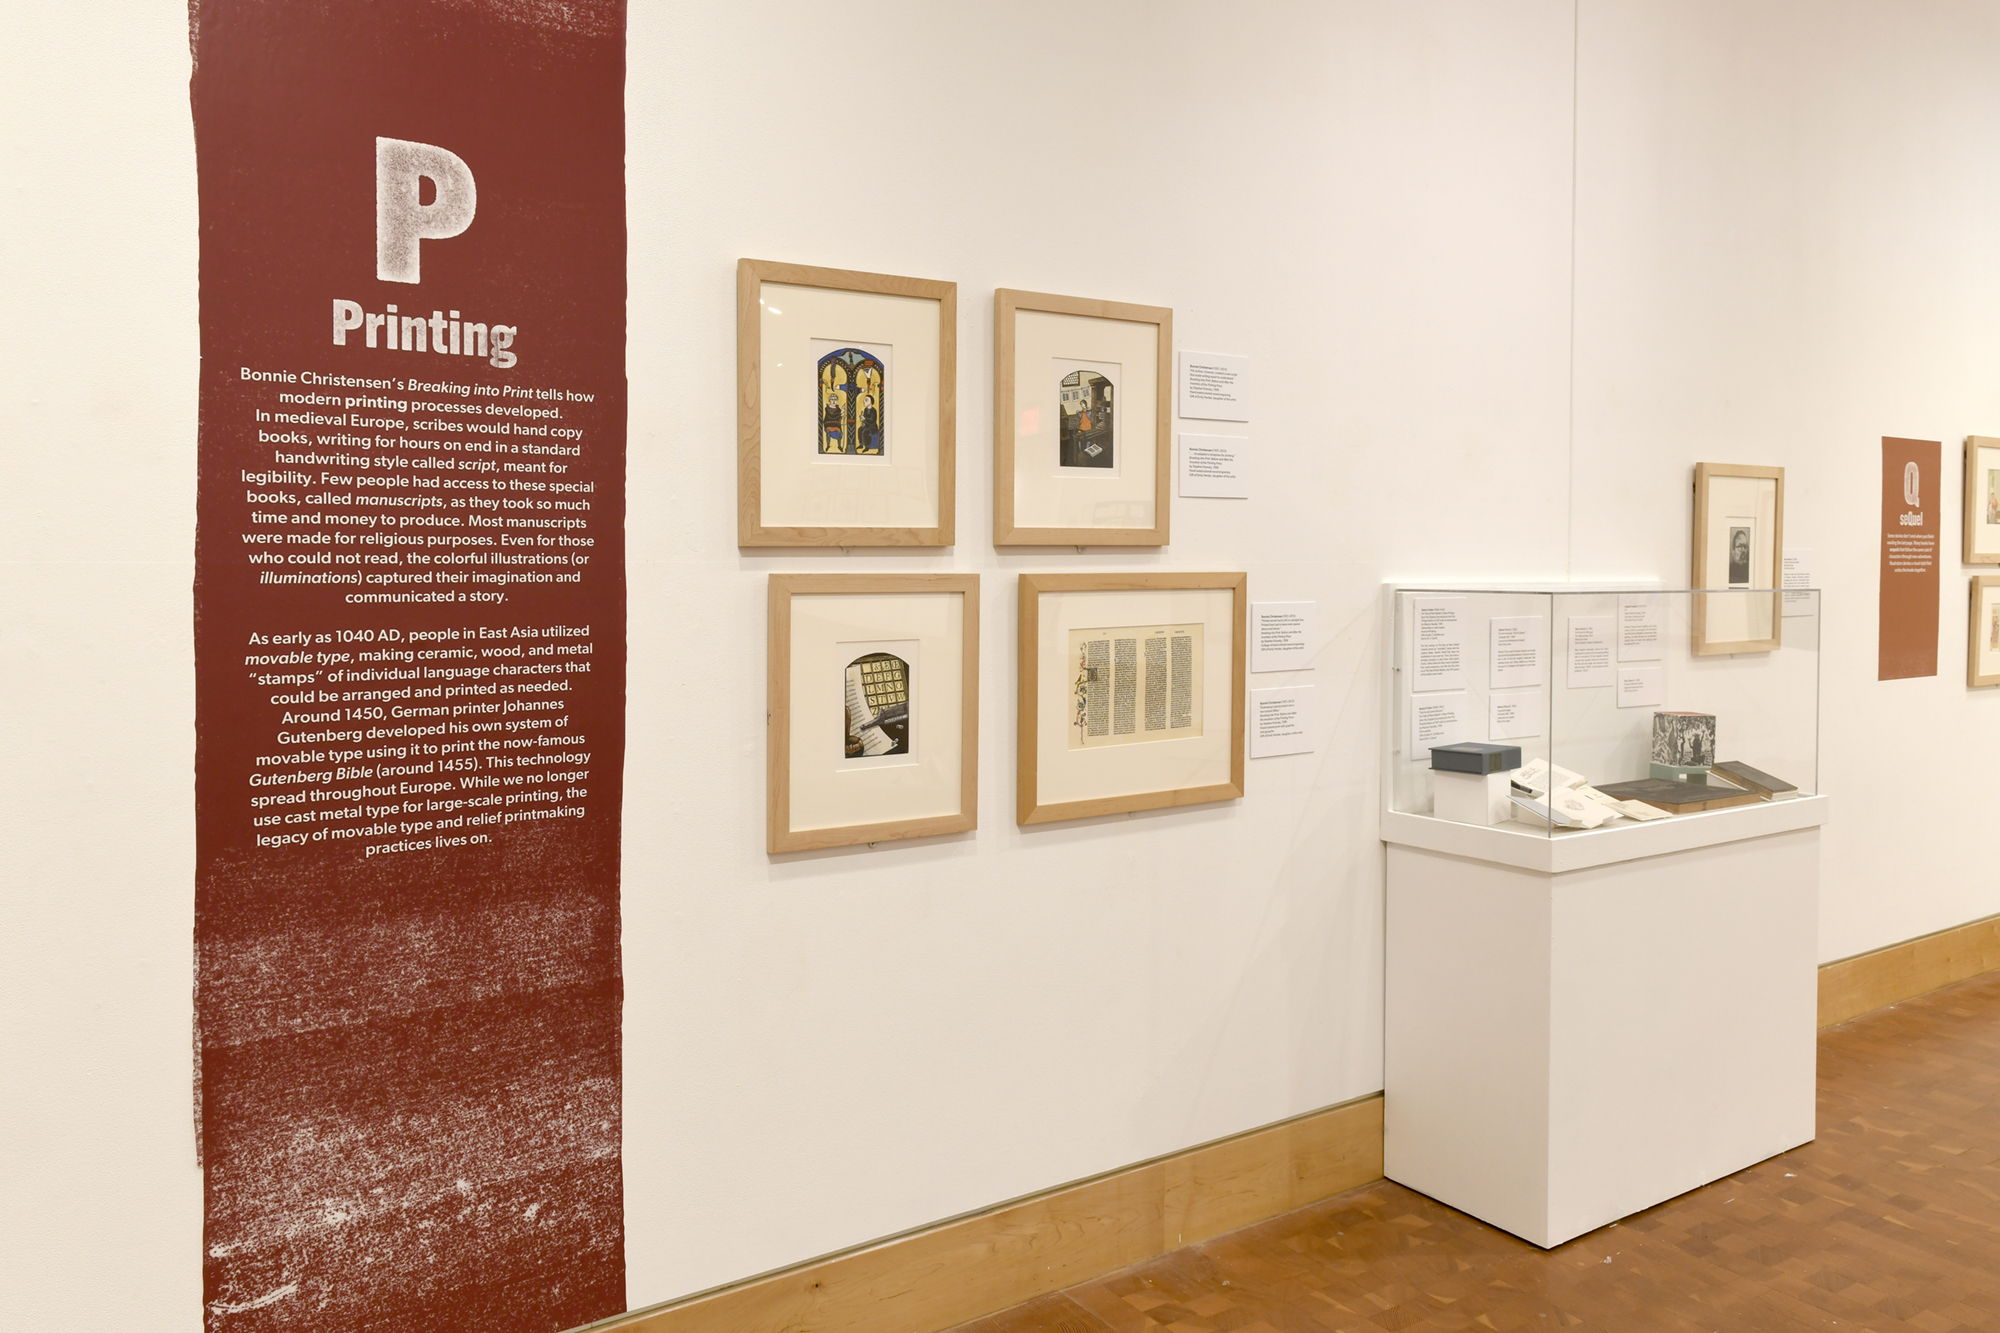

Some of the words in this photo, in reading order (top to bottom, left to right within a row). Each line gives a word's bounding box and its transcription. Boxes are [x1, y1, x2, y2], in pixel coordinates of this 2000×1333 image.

[376, 136, 477, 284] P
[333, 299, 517, 368] Printing
[240, 367, 297, 383] Bonnie
[300, 371, 405, 391] Christensen's
[407, 378, 471, 398] Breaking
[473, 383, 500, 397] into
[502, 385, 534, 399] Print
[535, 388, 564, 401] tells
[566, 389, 595, 403] how
[279, 392, 341, 406] modern
[345, 394, 408, 413] printing
[411, 401, 482, 414] processes
[485, 403, 563, 420] developed.
[256, 408, 270, 422] In
[275, 411, 346, 426] medieval
[351, 414, 409, 431] Europe,
[413, 418, 464, 432] scribes
[466, 422, 510, 435] would
[513, 423, 547, 436] hand
[550, 428, 583, 441] copy
[275, 450, 370, 469] handwriting
[374, 455, 409, 470] style
[411, 456, 455, 470] called
[458, 458, 500, 474] script,
[504, 462, 547, 473] meant
[548, 461, 568, 474] for
[1904, 461, 1920, 508] Q
[251, 510, 288, 524] time
[291, 511, 321, 524] and
[325, 515, 378, 528] money
[380, 514, 396, 526] to
[400, 514, 465, 528] produce.
[468, 514, 504, 527] Most
[506, 516, 587, 531] manuscripts
[1899, 511, 1923, 526] seQuel
[248, 551, 284, 564] who
[287, 551, 331, 564] could
[335, 552, 361, 564] not
[364, 551, 403, 566] read,
[406, 552, 431, 564] the
[433, 552, 487, 564] colorful
[491, 552, 569, 565] illustrations
[571, 552, 590, 567] (or
[260, 570, 362, 586] illuminations)
[366, 571, 432, 586] captured
[435, 571, 469, 583] their
[472, 570, 553, 586] imagination
[556, 571, 581, 583] and
[345, 590, 455, 603] communicated
[458, 593, 466, 602] a
[469, 590, 509, 604] story.
[248, 632, 269, 645] As
[272, 631, 312, 647] early
[315, 633, 332, 643] as
[335, 629, 374, 643] 1040
[377, 629, 405, 643] AD,
[409, 627, 460, 644] people
[463, 627, 476, 639] in
[479, 627, 508, 639] East
[510, 626, 539, 638] Asia
[541, 624, 590, 637] utilized
[245, 651, 313, 665] movable
[316, 651, 355, 666] type,
[359, 648, 414, 663] making
[417, 646, 478, 660] ceramic,
[481, 644, 525, 658] wood,
[528, 643, 554, 656] and
[557, 642, 593, 655] metal
[249, 670, 323, 687] "stamps"
[327, 669, 344, 682] of
[346, 666, 420, 682] individual
[424, 666, 490, 681] language
[493, 663, 563, 676] characters
[565, 661, 591, 673] that
[270, 690, 315, 705] could
[319, 690, 339, 702] be
[342, 686, 411, 702] arranged
[414, 684, 442, 698] and
[445, 682, 496, 699] printed
[499, 684, 515, 694] as
[517, 679, 572, 693] needed.
[281, 709, 341, 724] Around
[345, 706, 388, 721] 1450,
[391, 705, 449, 718] German
[453, 701, 501, 718] printer
[501, 699, 565, 715] Johannes
[277, 729, 362, 744] Gutenberg
[366, 722, 445, 739] developed
[449, 721, 469, 734] his
[472, 722, 502, 732] own
[505, 718, 552, 733] system
[555, 715, 569, 727] of
[249, 770, 333, 787] Gutenberg
[336, 766, 373, 780] Bible
[376, 761, 434, 779] (around
[437, 756, 482, 772] 1455).
[485, 755, 514, 768] This
[516, 751, 591, 766] technology
[251, 790, 306, 809] spread
[309, 784, 397, 802] throughout
[400, 781, 456, 794] Europe.
[459, 775, 500, 789] While
[503, 776, 524, 786] we
[527, 774, 544, 784] no
[547, 770, 590, 783] longer
[257, 832, 309, 848] legacy
[312, 827, 329, 841] of
[331, 822, 397, 839] movable
[400, 821, 433, 835] type
[436, 815, 463, 829] and
[466, 811, 502, 826] relief
[504, 805, 585, 825] printmaking
[366, 839, 432, 858] practices
[435, 835, 467, 848] lives
[470, 834, 492, 844] on.
